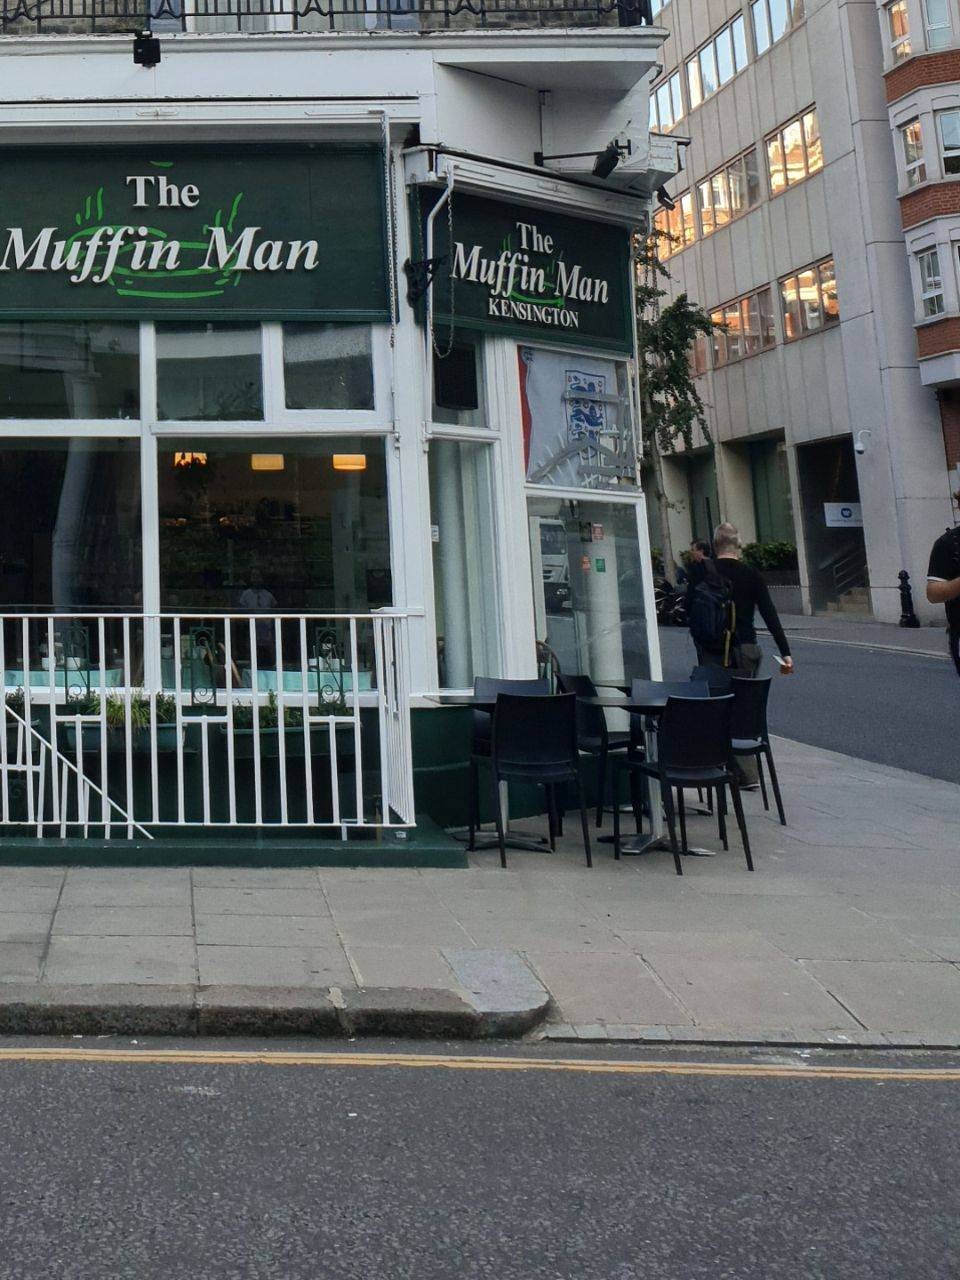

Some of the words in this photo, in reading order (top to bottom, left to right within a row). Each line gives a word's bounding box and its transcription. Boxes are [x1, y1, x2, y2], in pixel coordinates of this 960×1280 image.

[126, 176, 200, 208] The
[198, 226, 320, 271] Man
[516, 222, 554, 254] The
[451, 242, 545, 297] Muffin
[554, 261, 609, 304] Man
[489, 298, 579, 329] KENSINGTON
